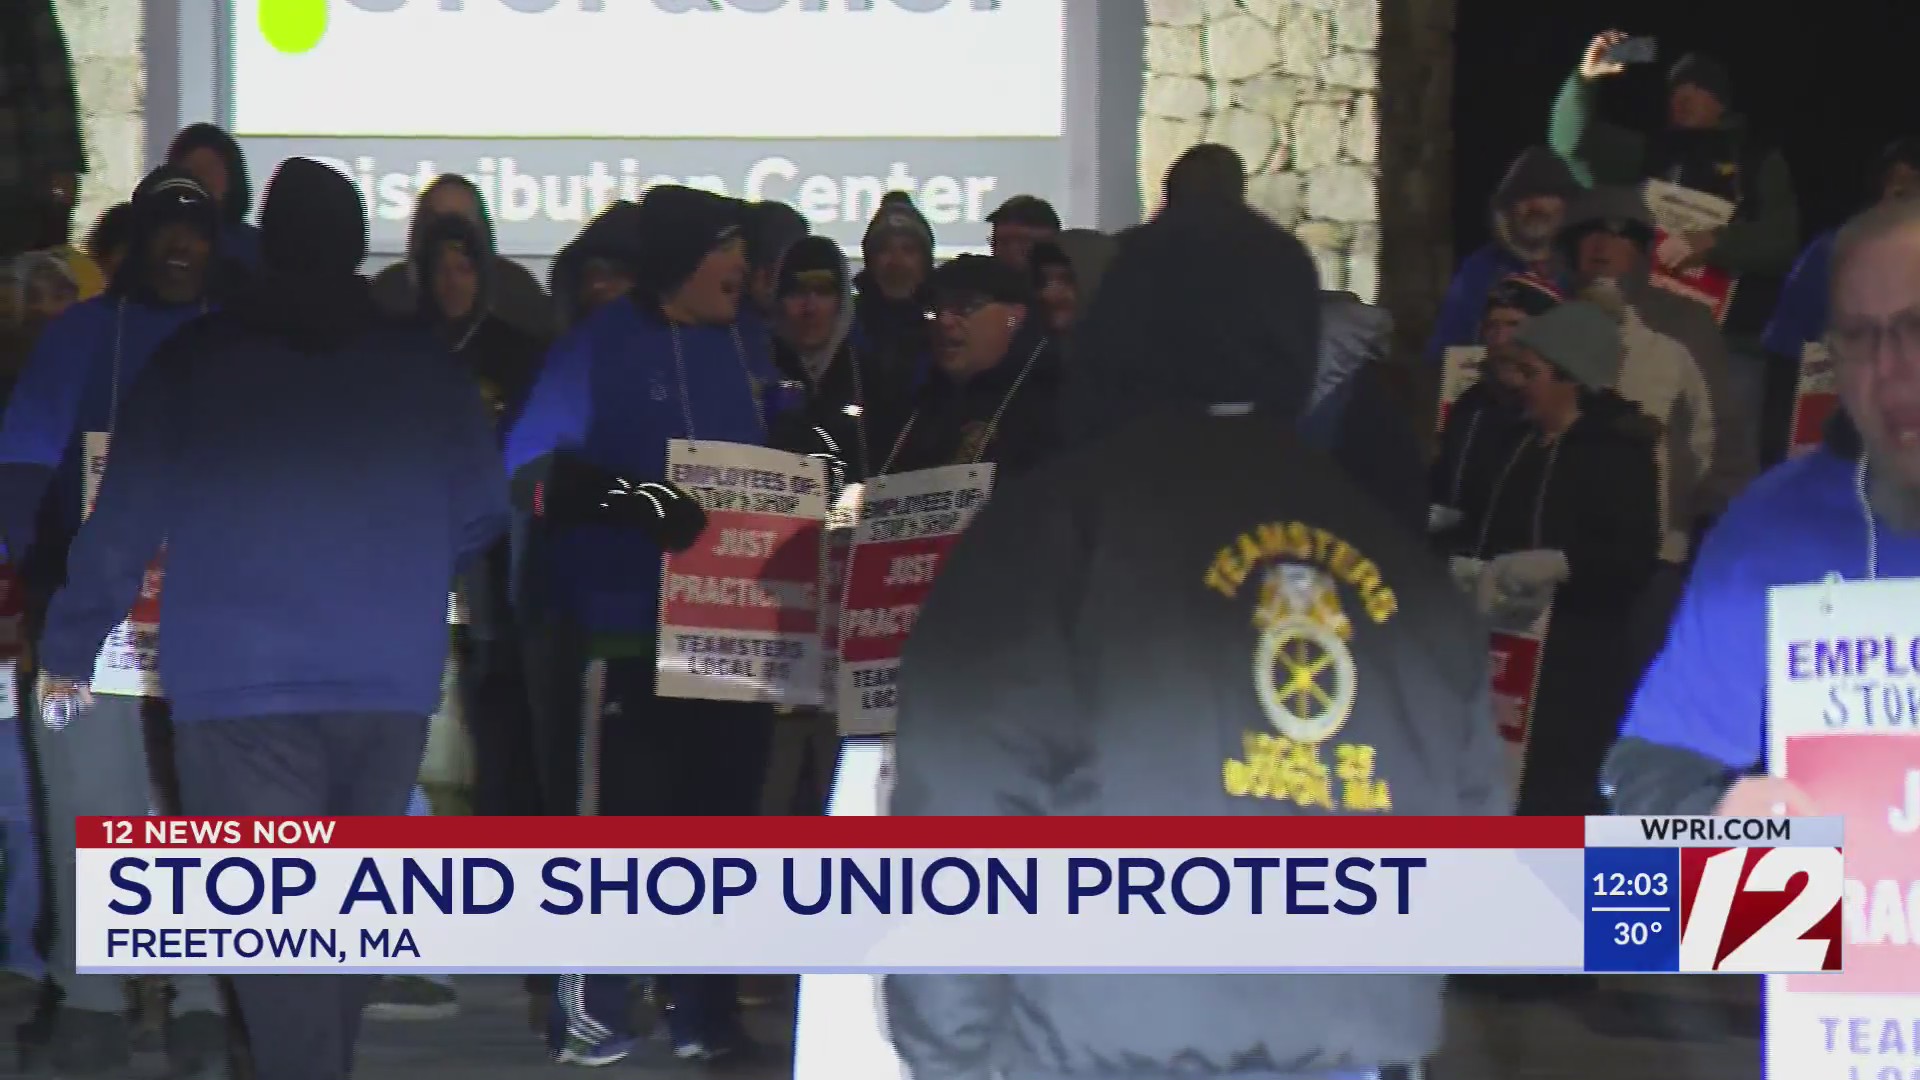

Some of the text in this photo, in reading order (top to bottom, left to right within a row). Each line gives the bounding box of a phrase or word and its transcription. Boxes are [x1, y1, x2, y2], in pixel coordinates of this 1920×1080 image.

[745, 157, 998, 223] Center
[671, 464, 788, 492] EMPLOYEES
[711, 528, 779, 559] JUST
[883, 553, 941, 585] JUST
[686, 656, 756, 678] LOCAL
[861, 688, 899, 709] LOC
